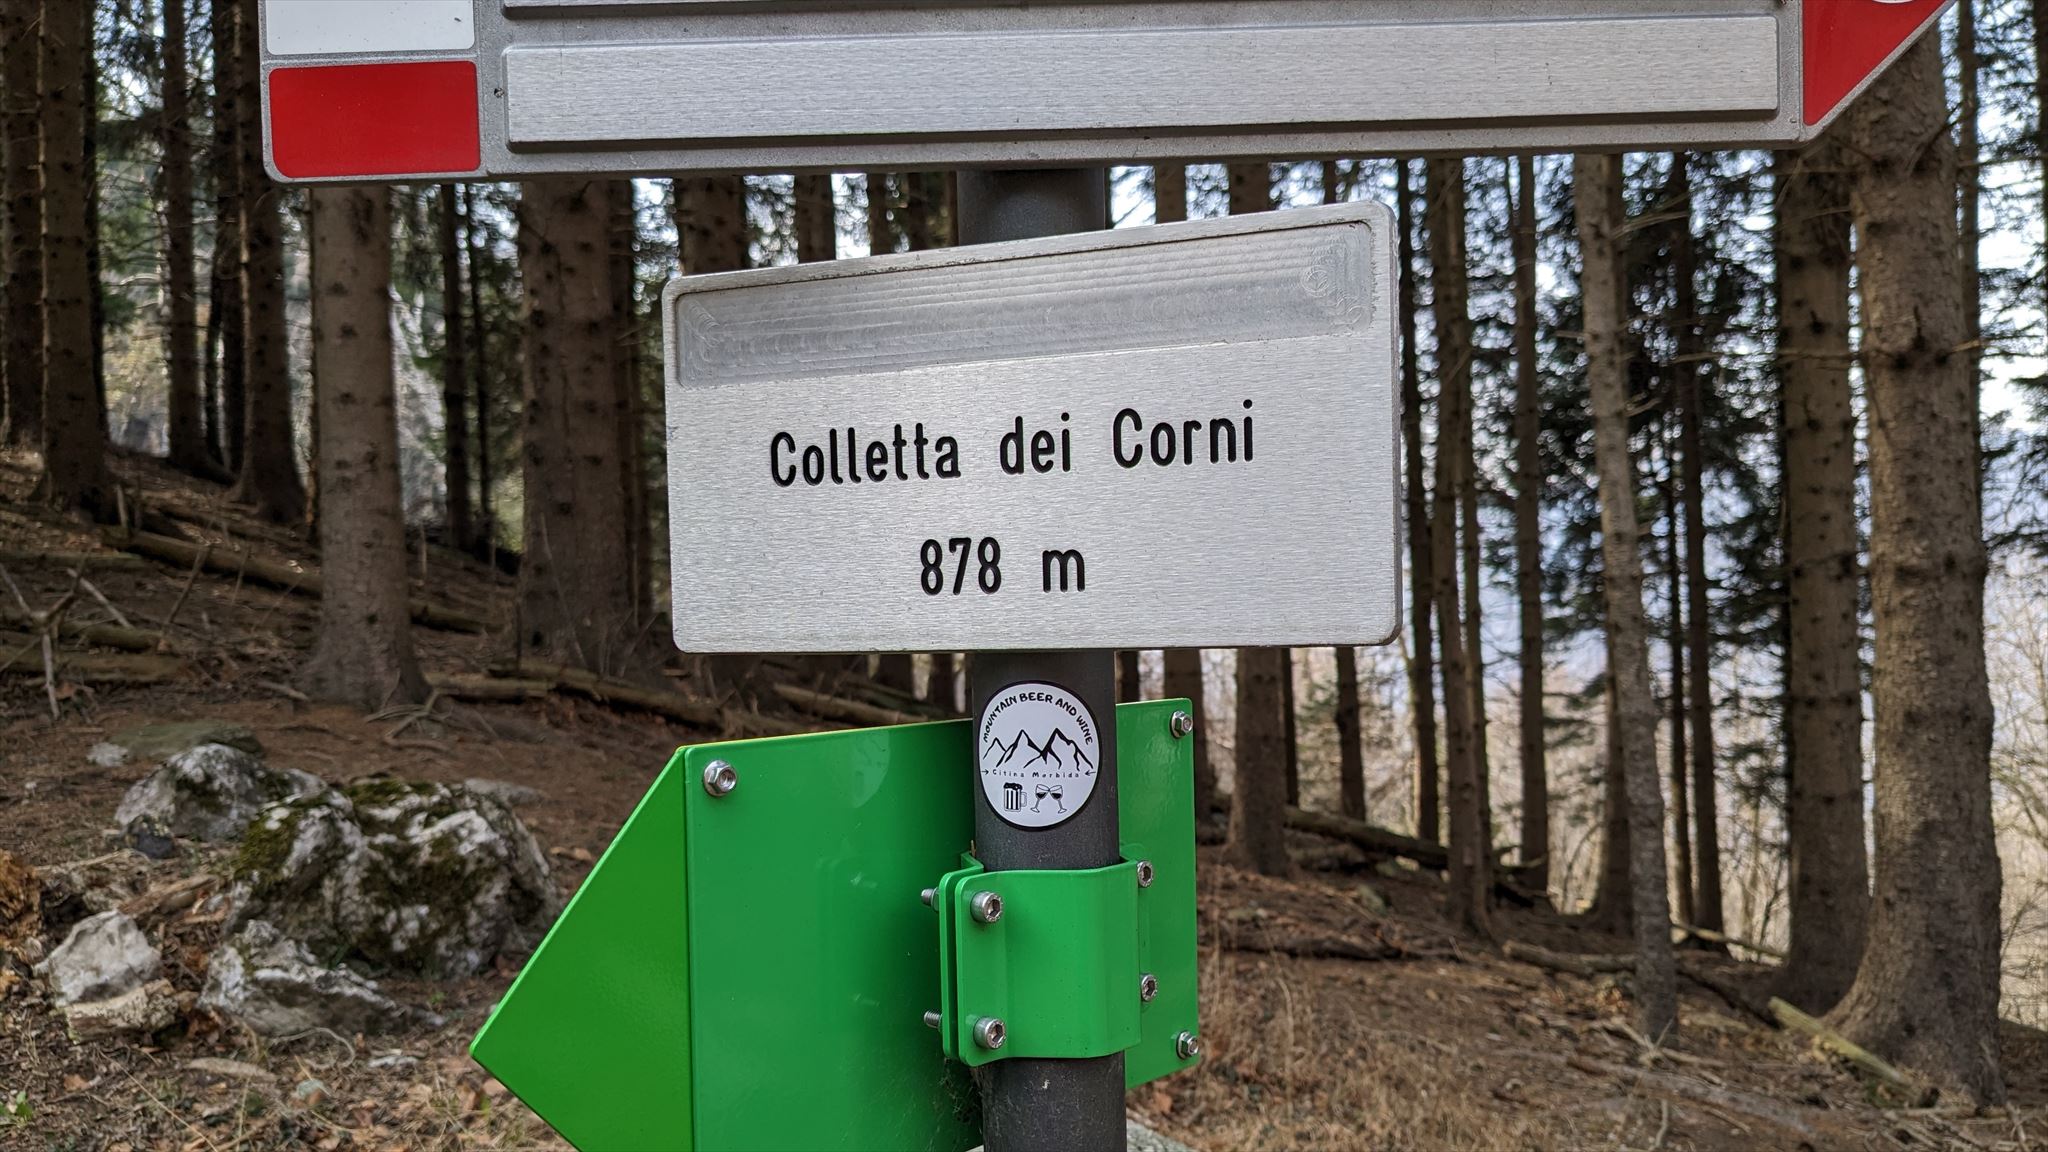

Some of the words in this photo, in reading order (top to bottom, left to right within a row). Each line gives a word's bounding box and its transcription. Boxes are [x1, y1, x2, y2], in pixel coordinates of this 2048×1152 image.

[770, 422, 962, 488] Colletta
[999, 412, 1071, 475] dei
[1112, 399, 1254, 469] Corni
[920, 536, 1002, 596] 878
[1042, 548, 1086, 593] m
[982, 695, 1018, 743] MOUNTAIN
[1019, 692, 1053, 704] BEER
[1055, 698, 1077, 717] AND
[1076, 715, 1093, 746] WINE
